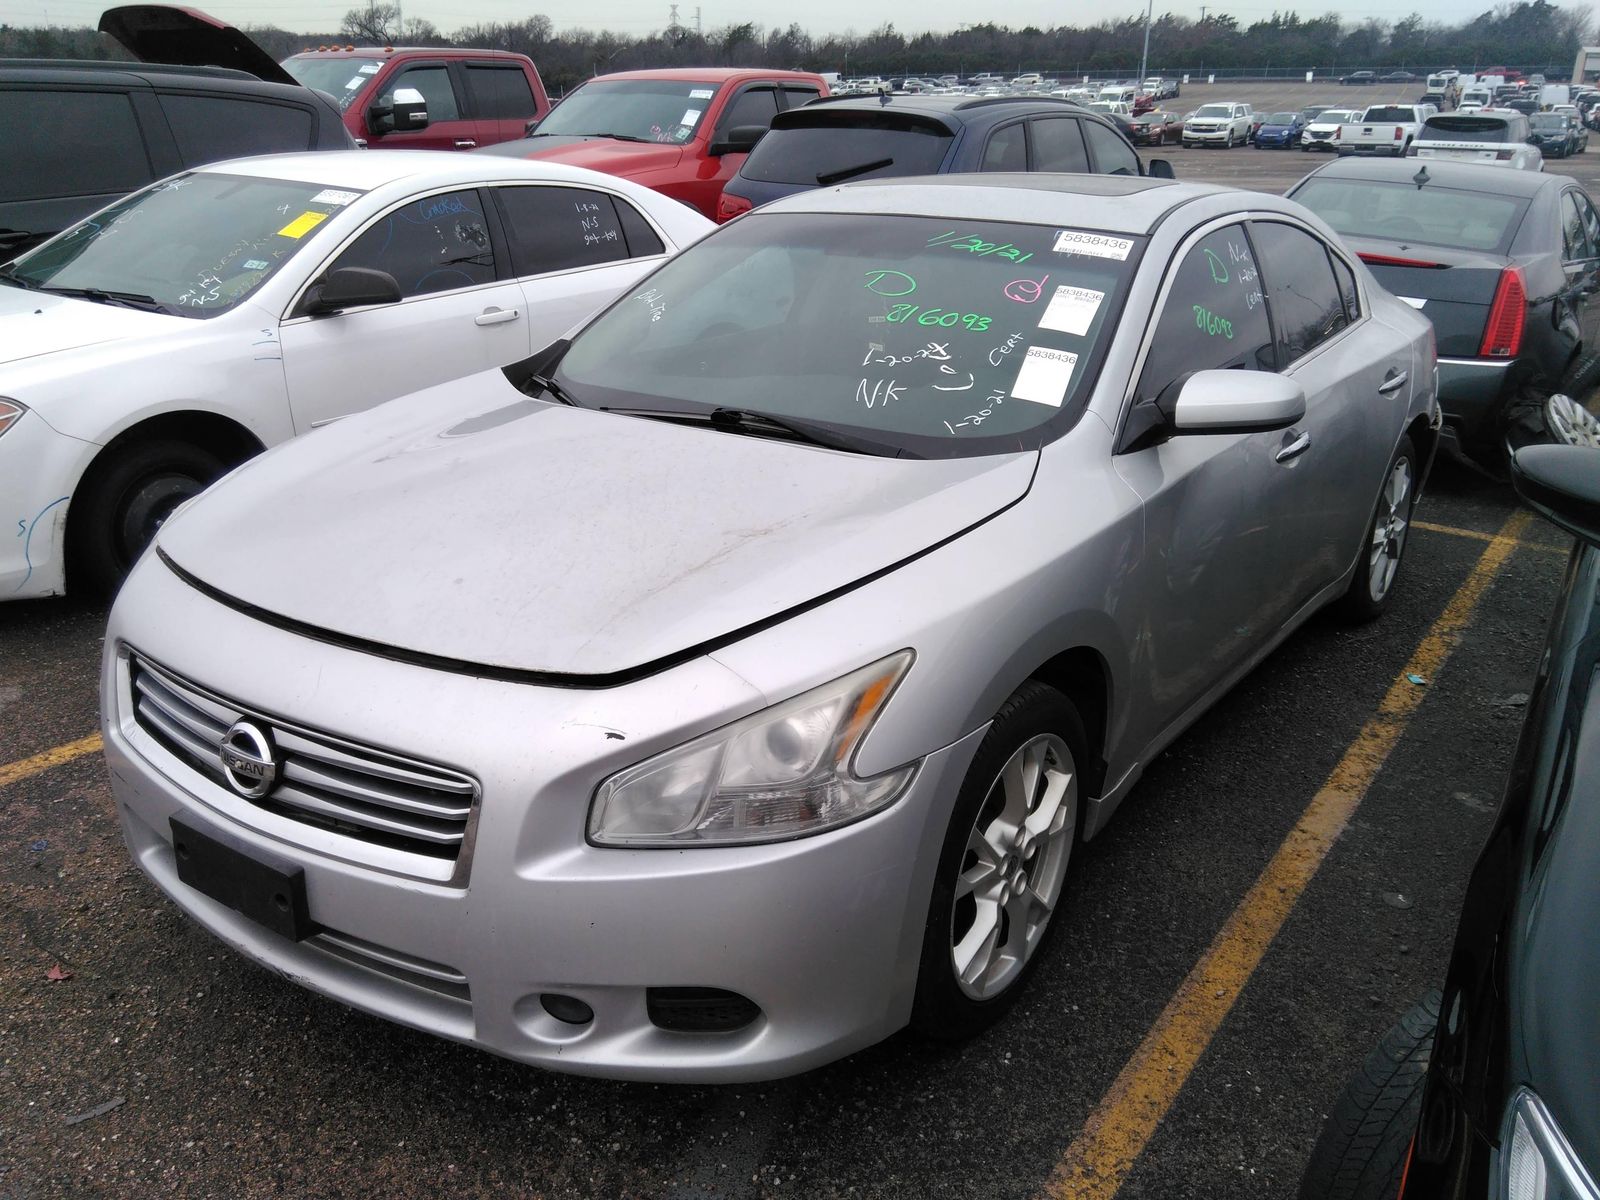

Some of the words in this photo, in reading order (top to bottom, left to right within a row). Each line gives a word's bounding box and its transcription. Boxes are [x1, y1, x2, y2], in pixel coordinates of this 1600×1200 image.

[1064, 233, 1128, 250] 5838436
[1055, 287, 1103, 301] 5838436
[886, 304, 993, 331] 816093
[1027, 348, 1077, 365] 5838436
